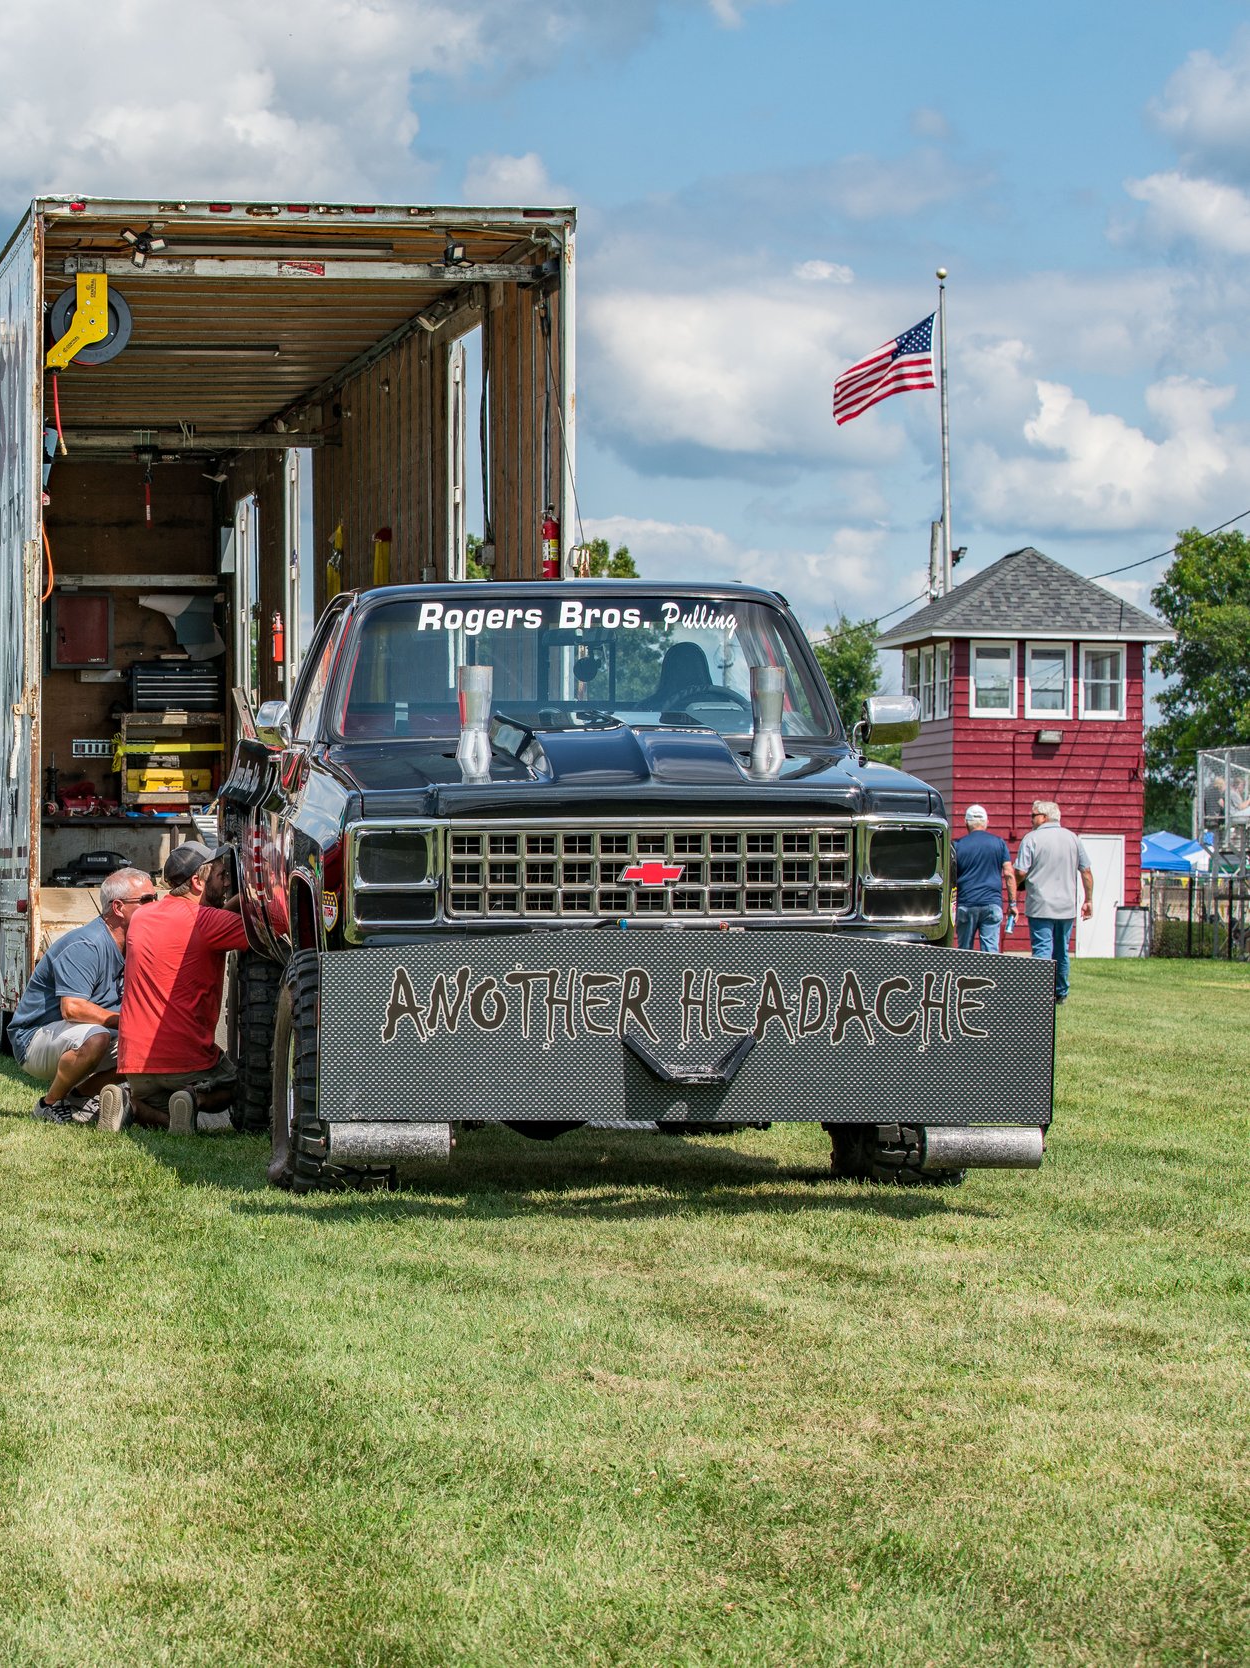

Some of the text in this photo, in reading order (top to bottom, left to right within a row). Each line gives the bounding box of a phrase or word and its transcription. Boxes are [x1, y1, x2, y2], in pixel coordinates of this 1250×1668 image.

[417, 601, 738, 639] Rogers Bros. Pulling
[381, 964, 996, 1050] ANOTHER HEADACHE
